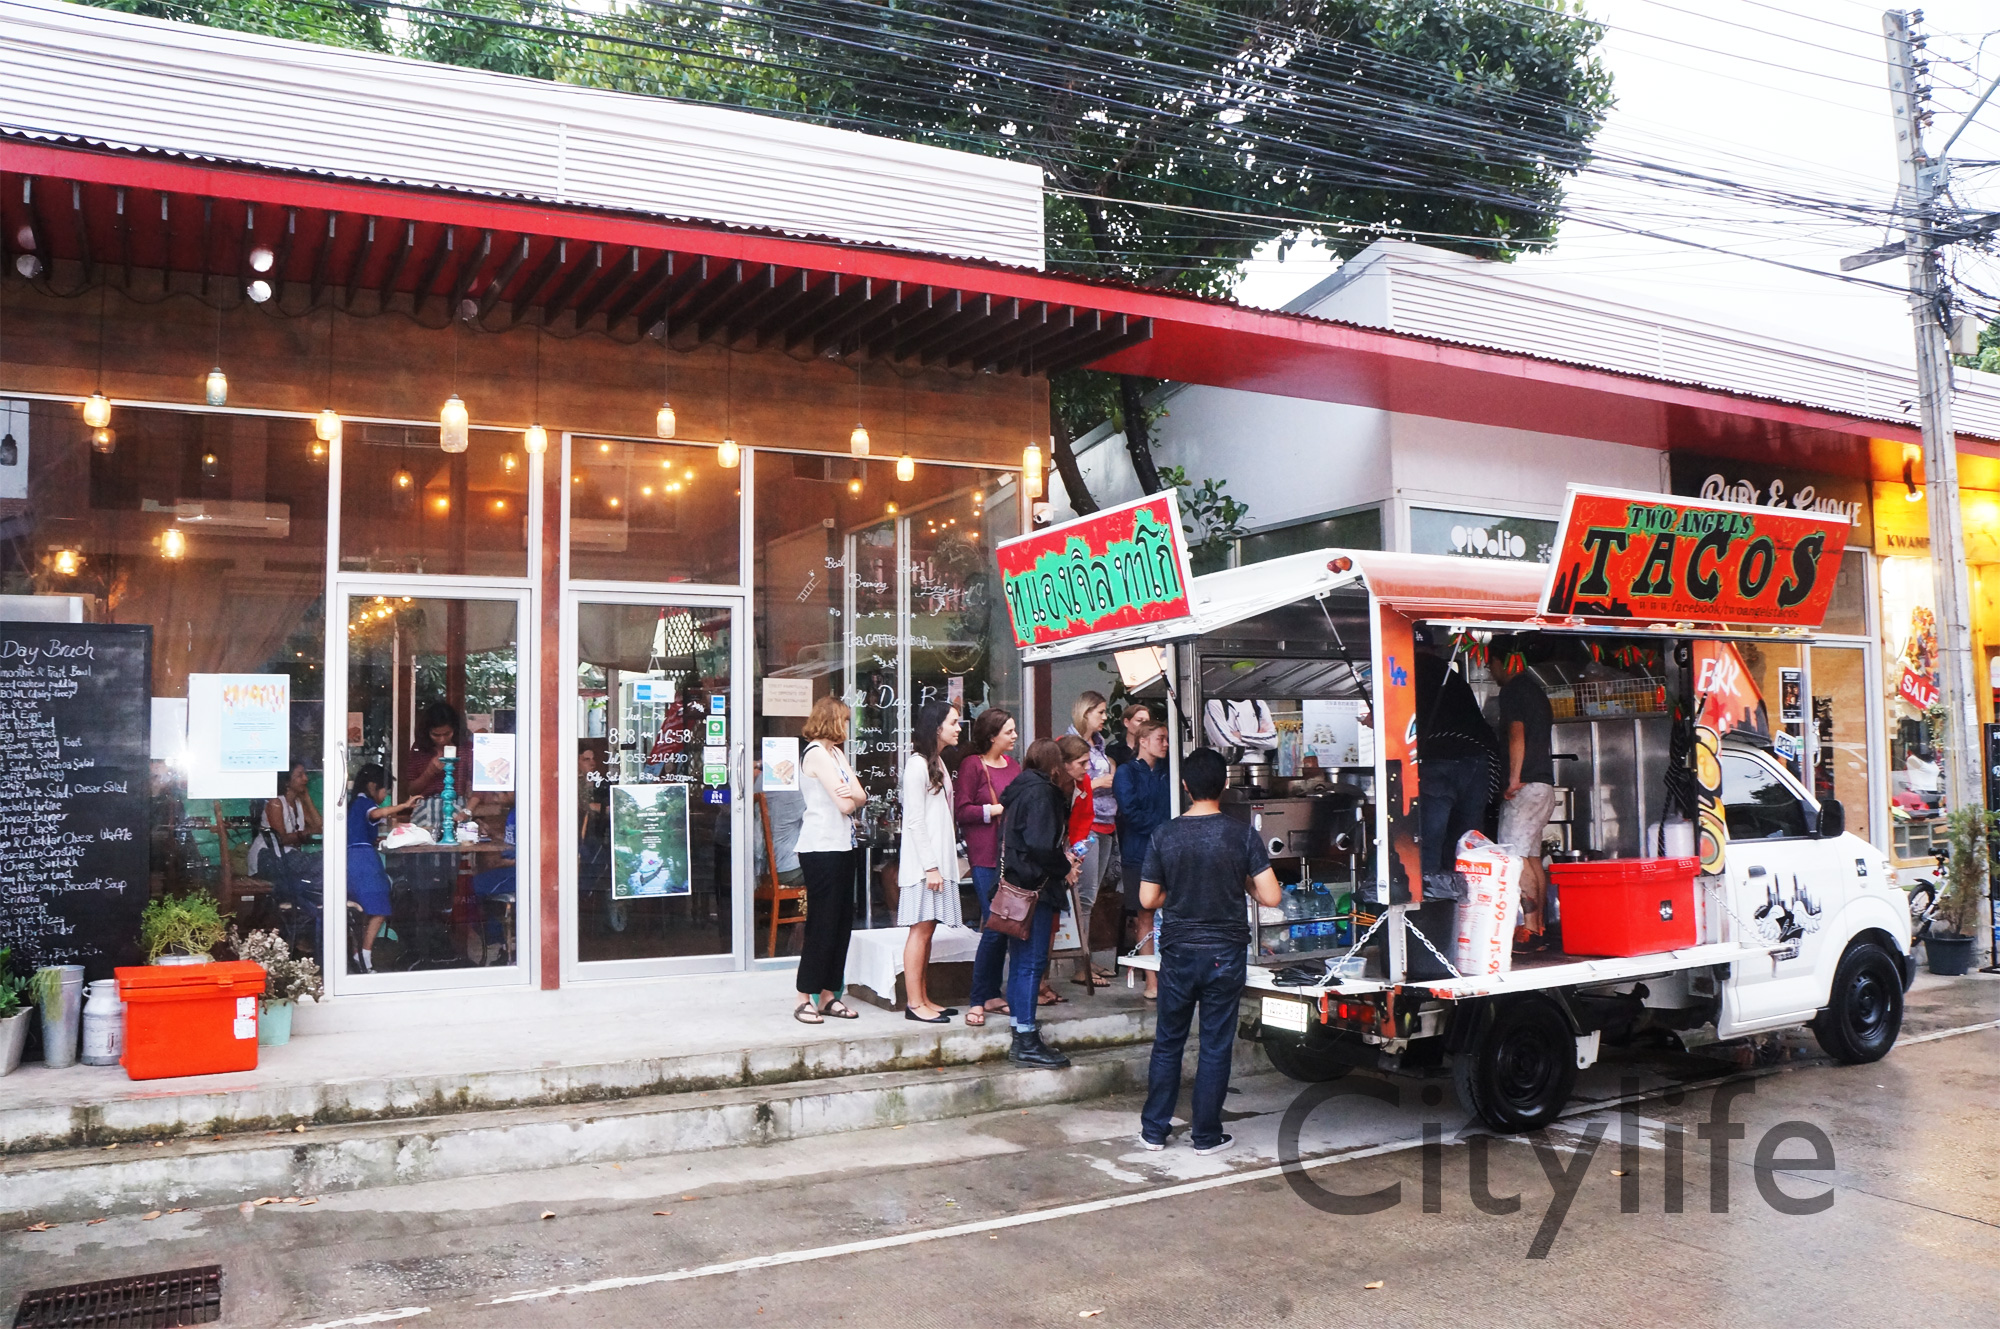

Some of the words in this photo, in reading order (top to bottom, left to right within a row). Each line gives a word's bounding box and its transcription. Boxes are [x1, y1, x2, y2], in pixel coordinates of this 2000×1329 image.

[1631, 507, 1674, 530] TWO
[1679, 513, 1752, 536] ANGELS
[1577, 526, 1827, 609] TACOS
[0, 640, 39, 665] Day
[0, 664, 36, 678] moothie
[1902, 674, 1940, 709] SALE
